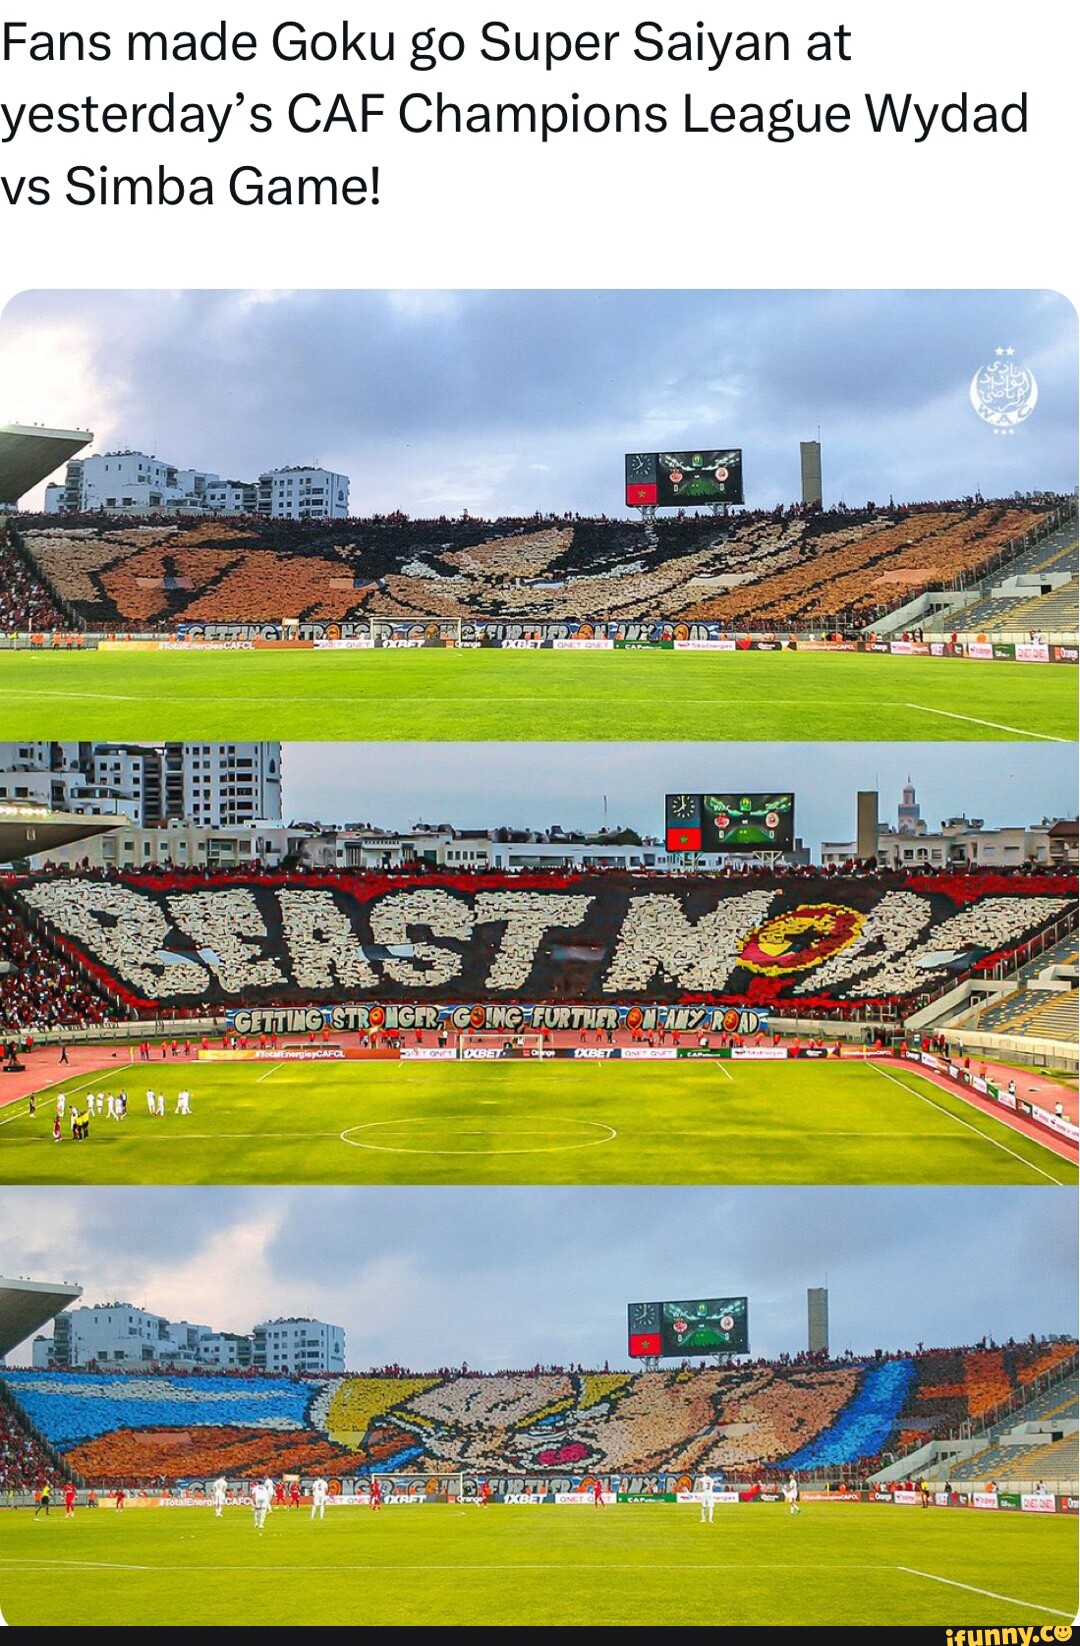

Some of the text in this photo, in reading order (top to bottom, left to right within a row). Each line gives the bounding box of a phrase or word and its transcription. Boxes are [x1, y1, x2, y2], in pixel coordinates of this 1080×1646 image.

[16, 878, 597, 1000] BEAST
[234, 1009, 323, 1034] GETTING
[451, 1005, 524, 1031] GOING
[531, 1006, 619, 1031] FURTHER
[626, 1006, 658, 1031] ON
[663, 1008, 707, 1032] ANY
[711, 1009, 760, 1035] ROAD
[383, 1495, 427, 1504] 1XBET
[503, 1495, 547, 1504] 1XBET
